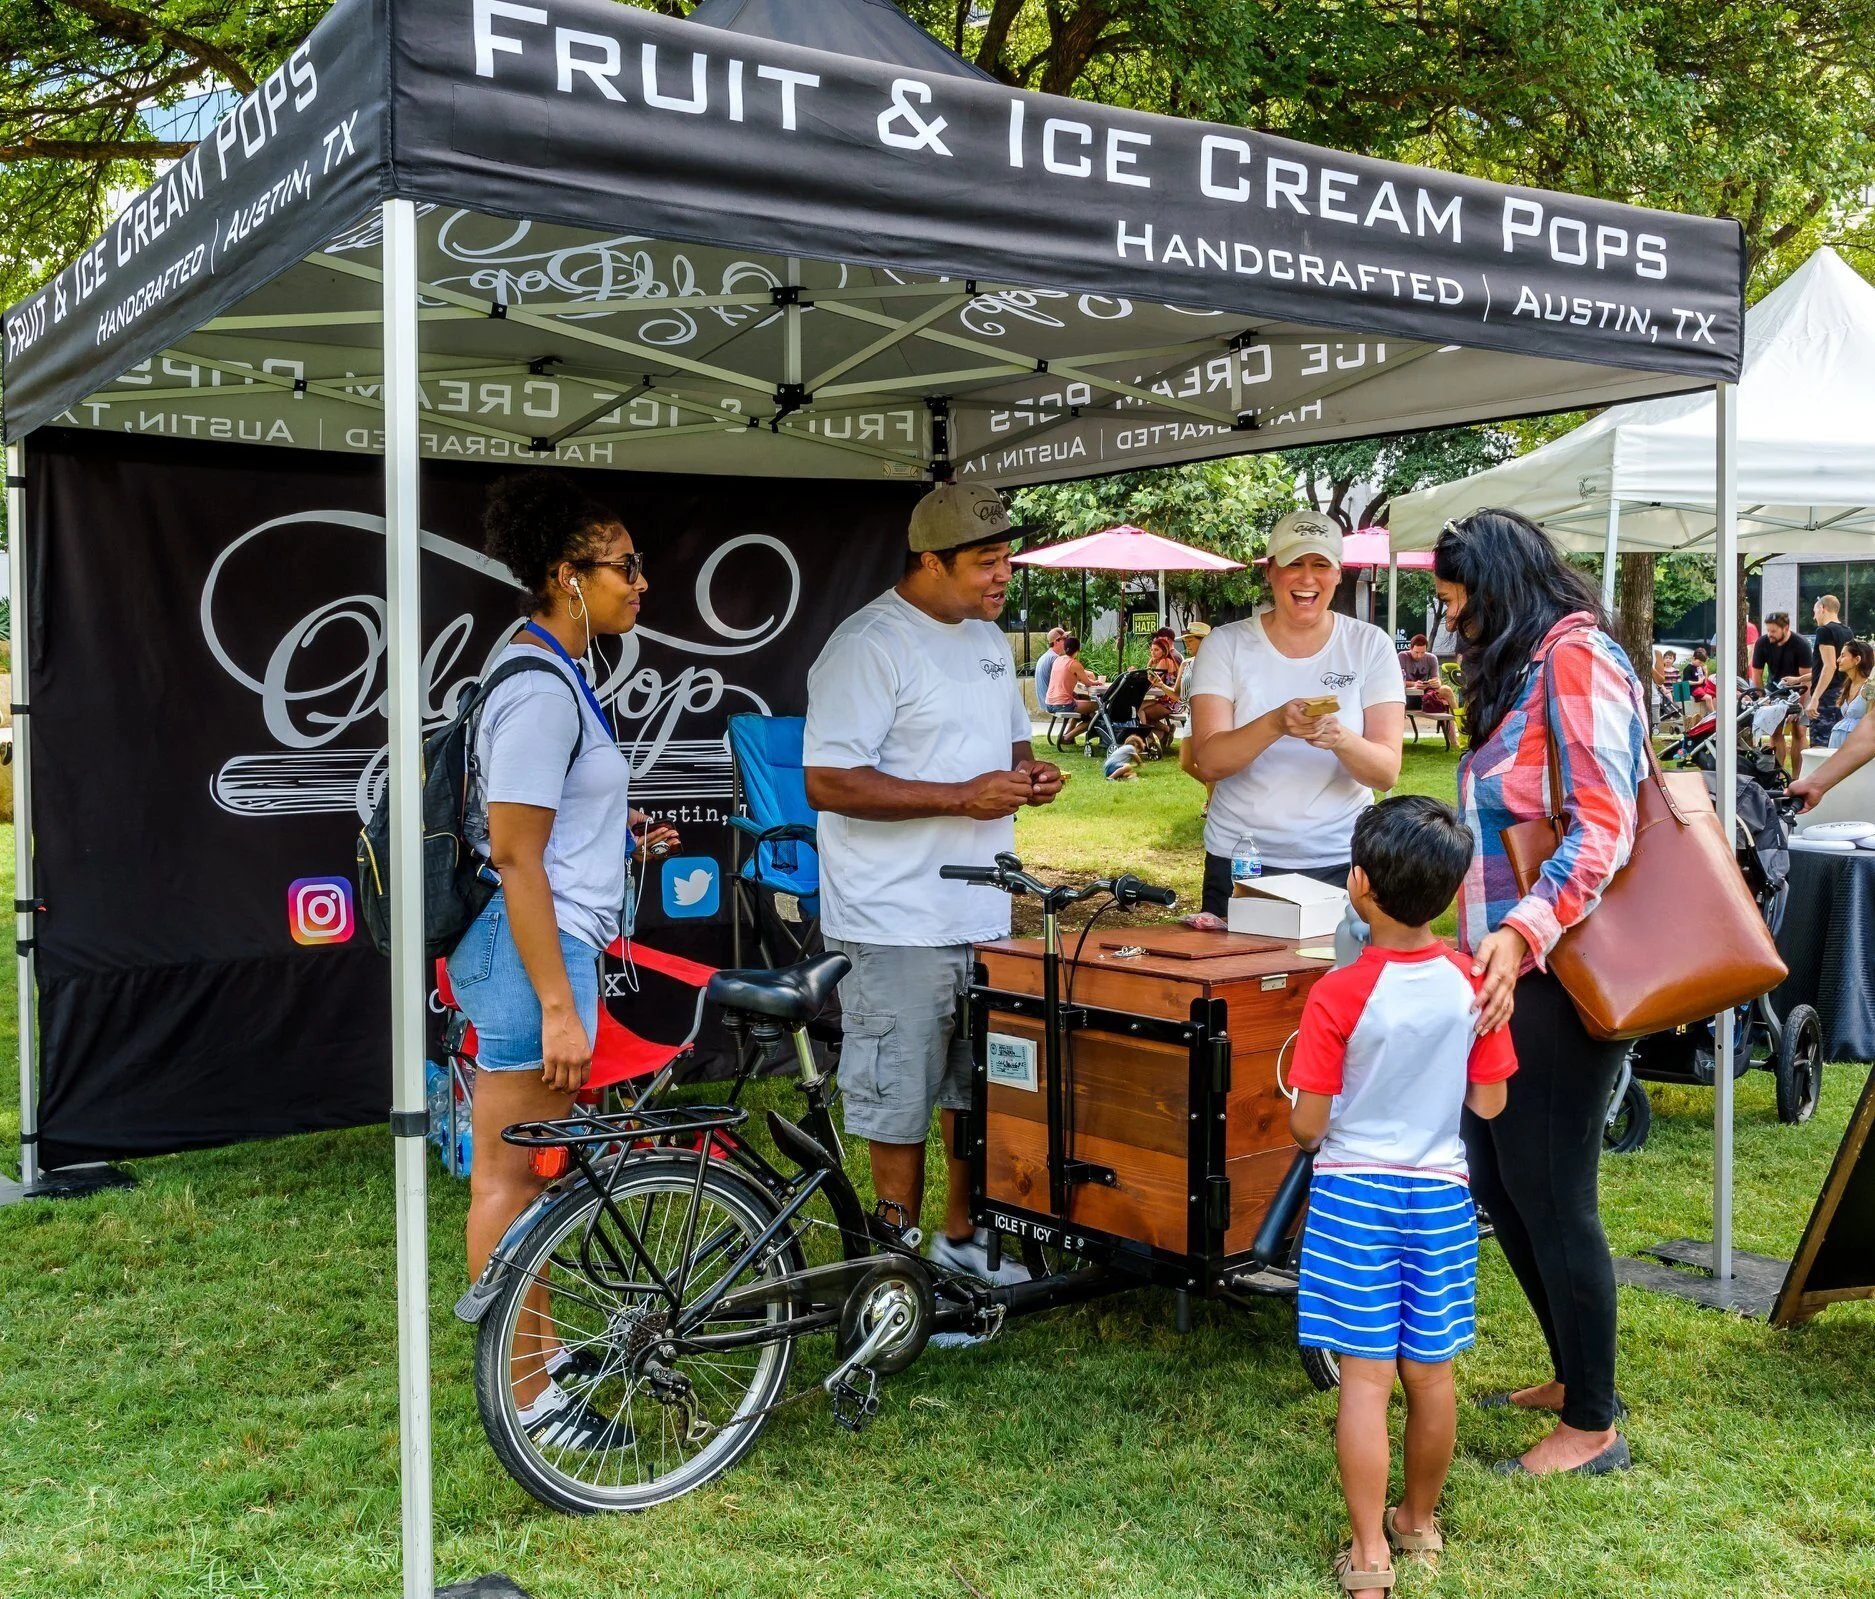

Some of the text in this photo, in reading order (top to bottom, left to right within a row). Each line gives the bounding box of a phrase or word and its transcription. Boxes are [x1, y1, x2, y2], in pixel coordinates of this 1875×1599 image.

[7, 40, 318, 363] FRUIT & ICE CREAM POPS
[96, 243, 205, 346] HANDCRAFTED
[223, 160, 312, 252] AUSTIN,
[323, 109, 359, 175] TX
[473, 0, 1668, 280] FRUIT & ICE CREAM POPS
[1116, 220, 1465, 306] HANDCRAFTED
[1512, 285, 1658, 344] AUSTIN,
[1671, 308, 1717, 345] TX
[1135, 621, 1157, 633] HAIR
